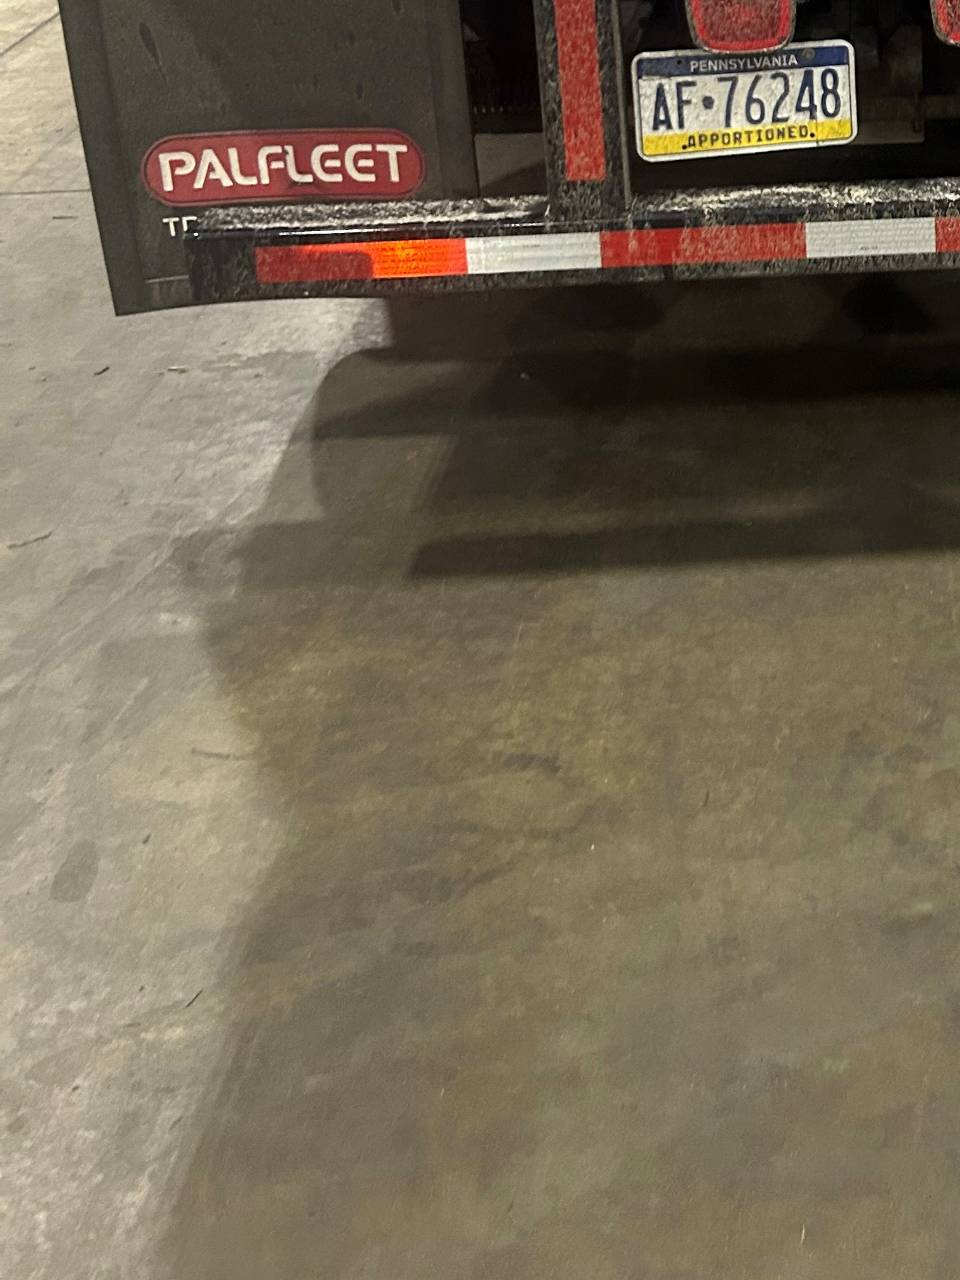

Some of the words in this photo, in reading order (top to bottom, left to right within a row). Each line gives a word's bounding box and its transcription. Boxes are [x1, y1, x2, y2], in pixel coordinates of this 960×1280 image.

[690, 55, 798, 72] PENNSYLVANIA
[687, 124, 809, 149] APPORTIONED
[157, 143, 409, 192] PALFLEET
